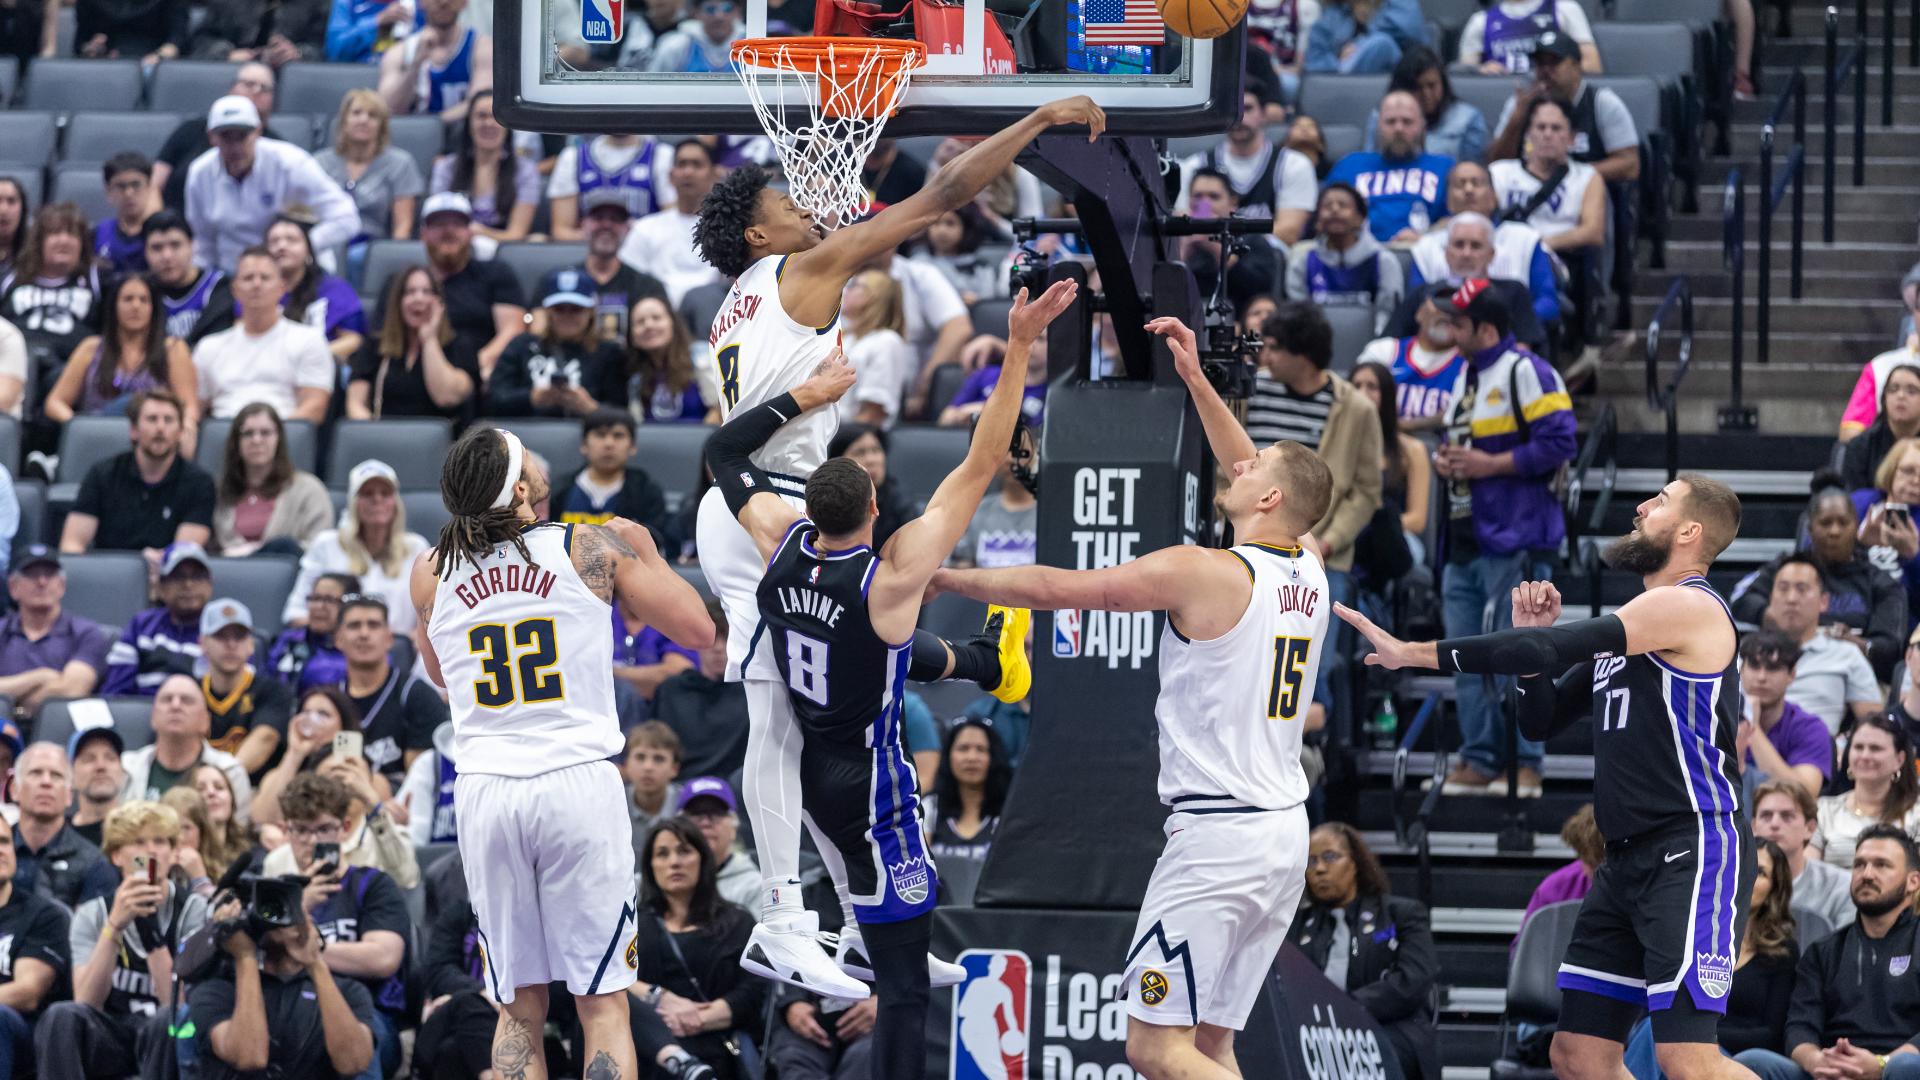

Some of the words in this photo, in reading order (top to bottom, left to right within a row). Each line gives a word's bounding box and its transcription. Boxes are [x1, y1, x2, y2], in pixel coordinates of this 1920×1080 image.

[586, 21, 607, 37] NBA
[1355, 168, 1439, 203] KINGS
[1397, 384, 1453, 419] INGS
[1073, 467, 1141, 526] GET
[454, 564, 558, 610] GORDON
[777, 586, 845, 629] LAVINE
[1277, 584, 1319, 619] JOKIĆ
[1084, 609, 1154, 669] App
[467, 616, 565, 709] 32
[784, 628, 831, 708] 8
[1267, 635, 1313, 721] 15
[1603, 687, 1631, 731] 17
[895, 872, 928, 891] KINGS
[1044, 954, 1128, 1042] Lea
[1699, 970, 1729, 982] KINGS
[1300, 1003, 1387, 1080] coinbase
